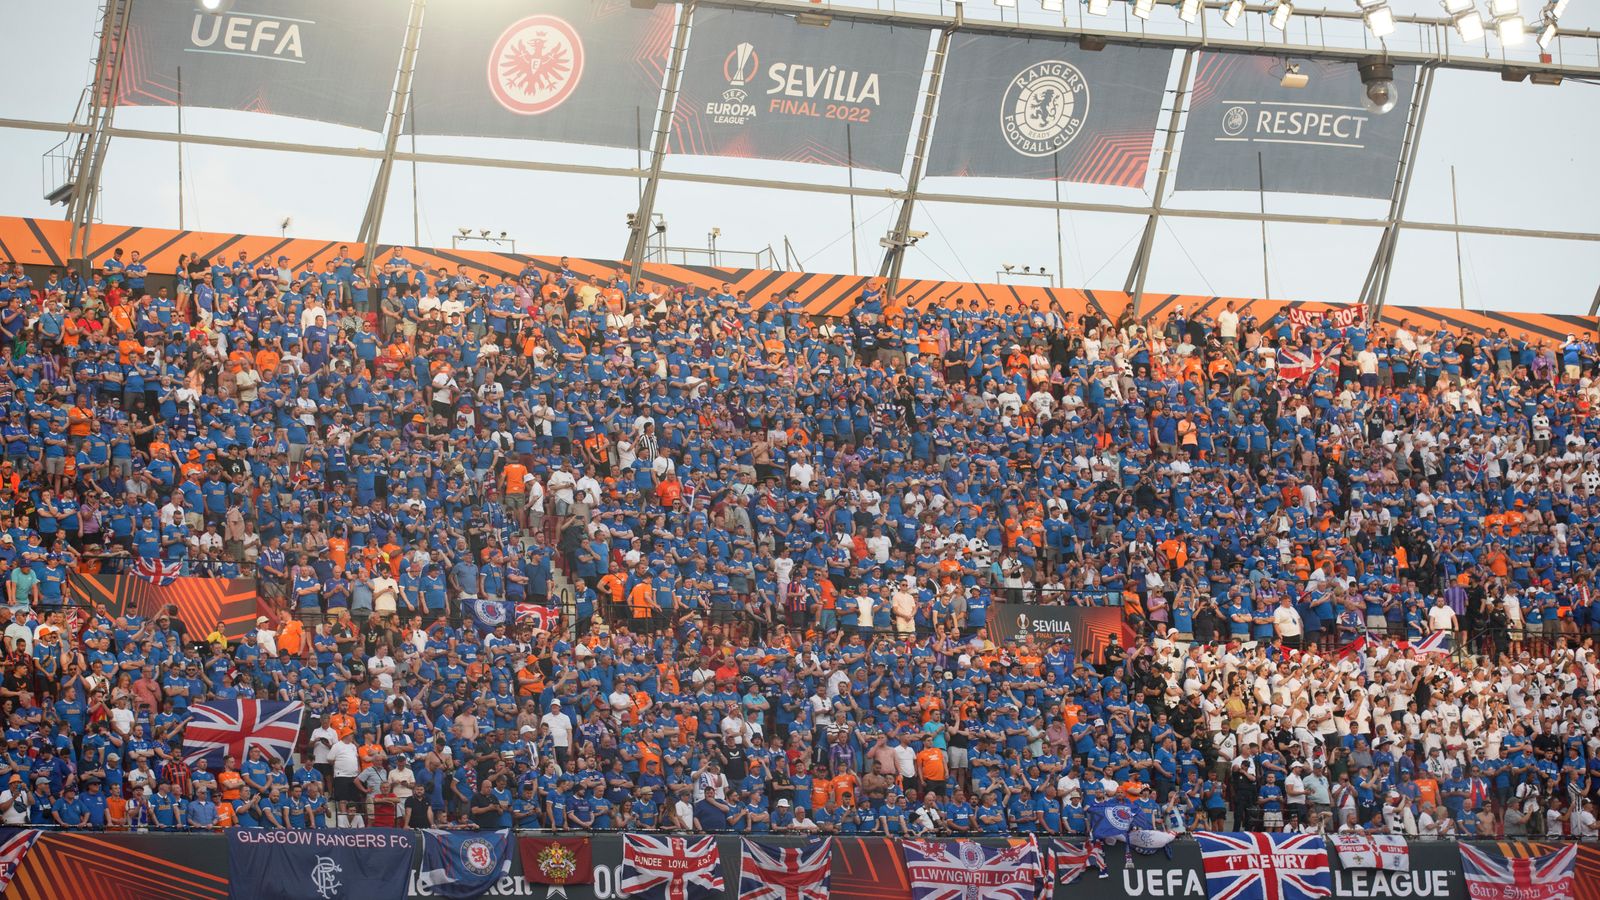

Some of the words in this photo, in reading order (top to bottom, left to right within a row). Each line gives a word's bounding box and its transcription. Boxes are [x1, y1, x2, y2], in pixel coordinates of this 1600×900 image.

[191, 14, 303, 58] UEFA
[1016, 64, 1084, 94] RANGERS
[723, 90, 746, 102] UEFA
[706, 102, 757, 117] EUROPA
[769, 99, 821, 117] FINAL
[825, 104, 871, 123] 2022
[714, 115, 745, 125] LEAGUE
[1256, 110, 1369, 139] RESPECT
[1005, 115, 1052, 152] FOOTBALL
[1053, 118, 1080, 146] CLUB
[237, 830, 312, 845] GLASGOW
[316, 833, 386, 848] RANGERS
[668, 859, 688, 869] LOYAL
[1247, 854, 1308, 869] NEWRY
[913, 868, 989, 885] LLWYNGWRIL
[994, 869, 1032, 884] LOYAL
[1123, 869, 1205, 897] UEFA
